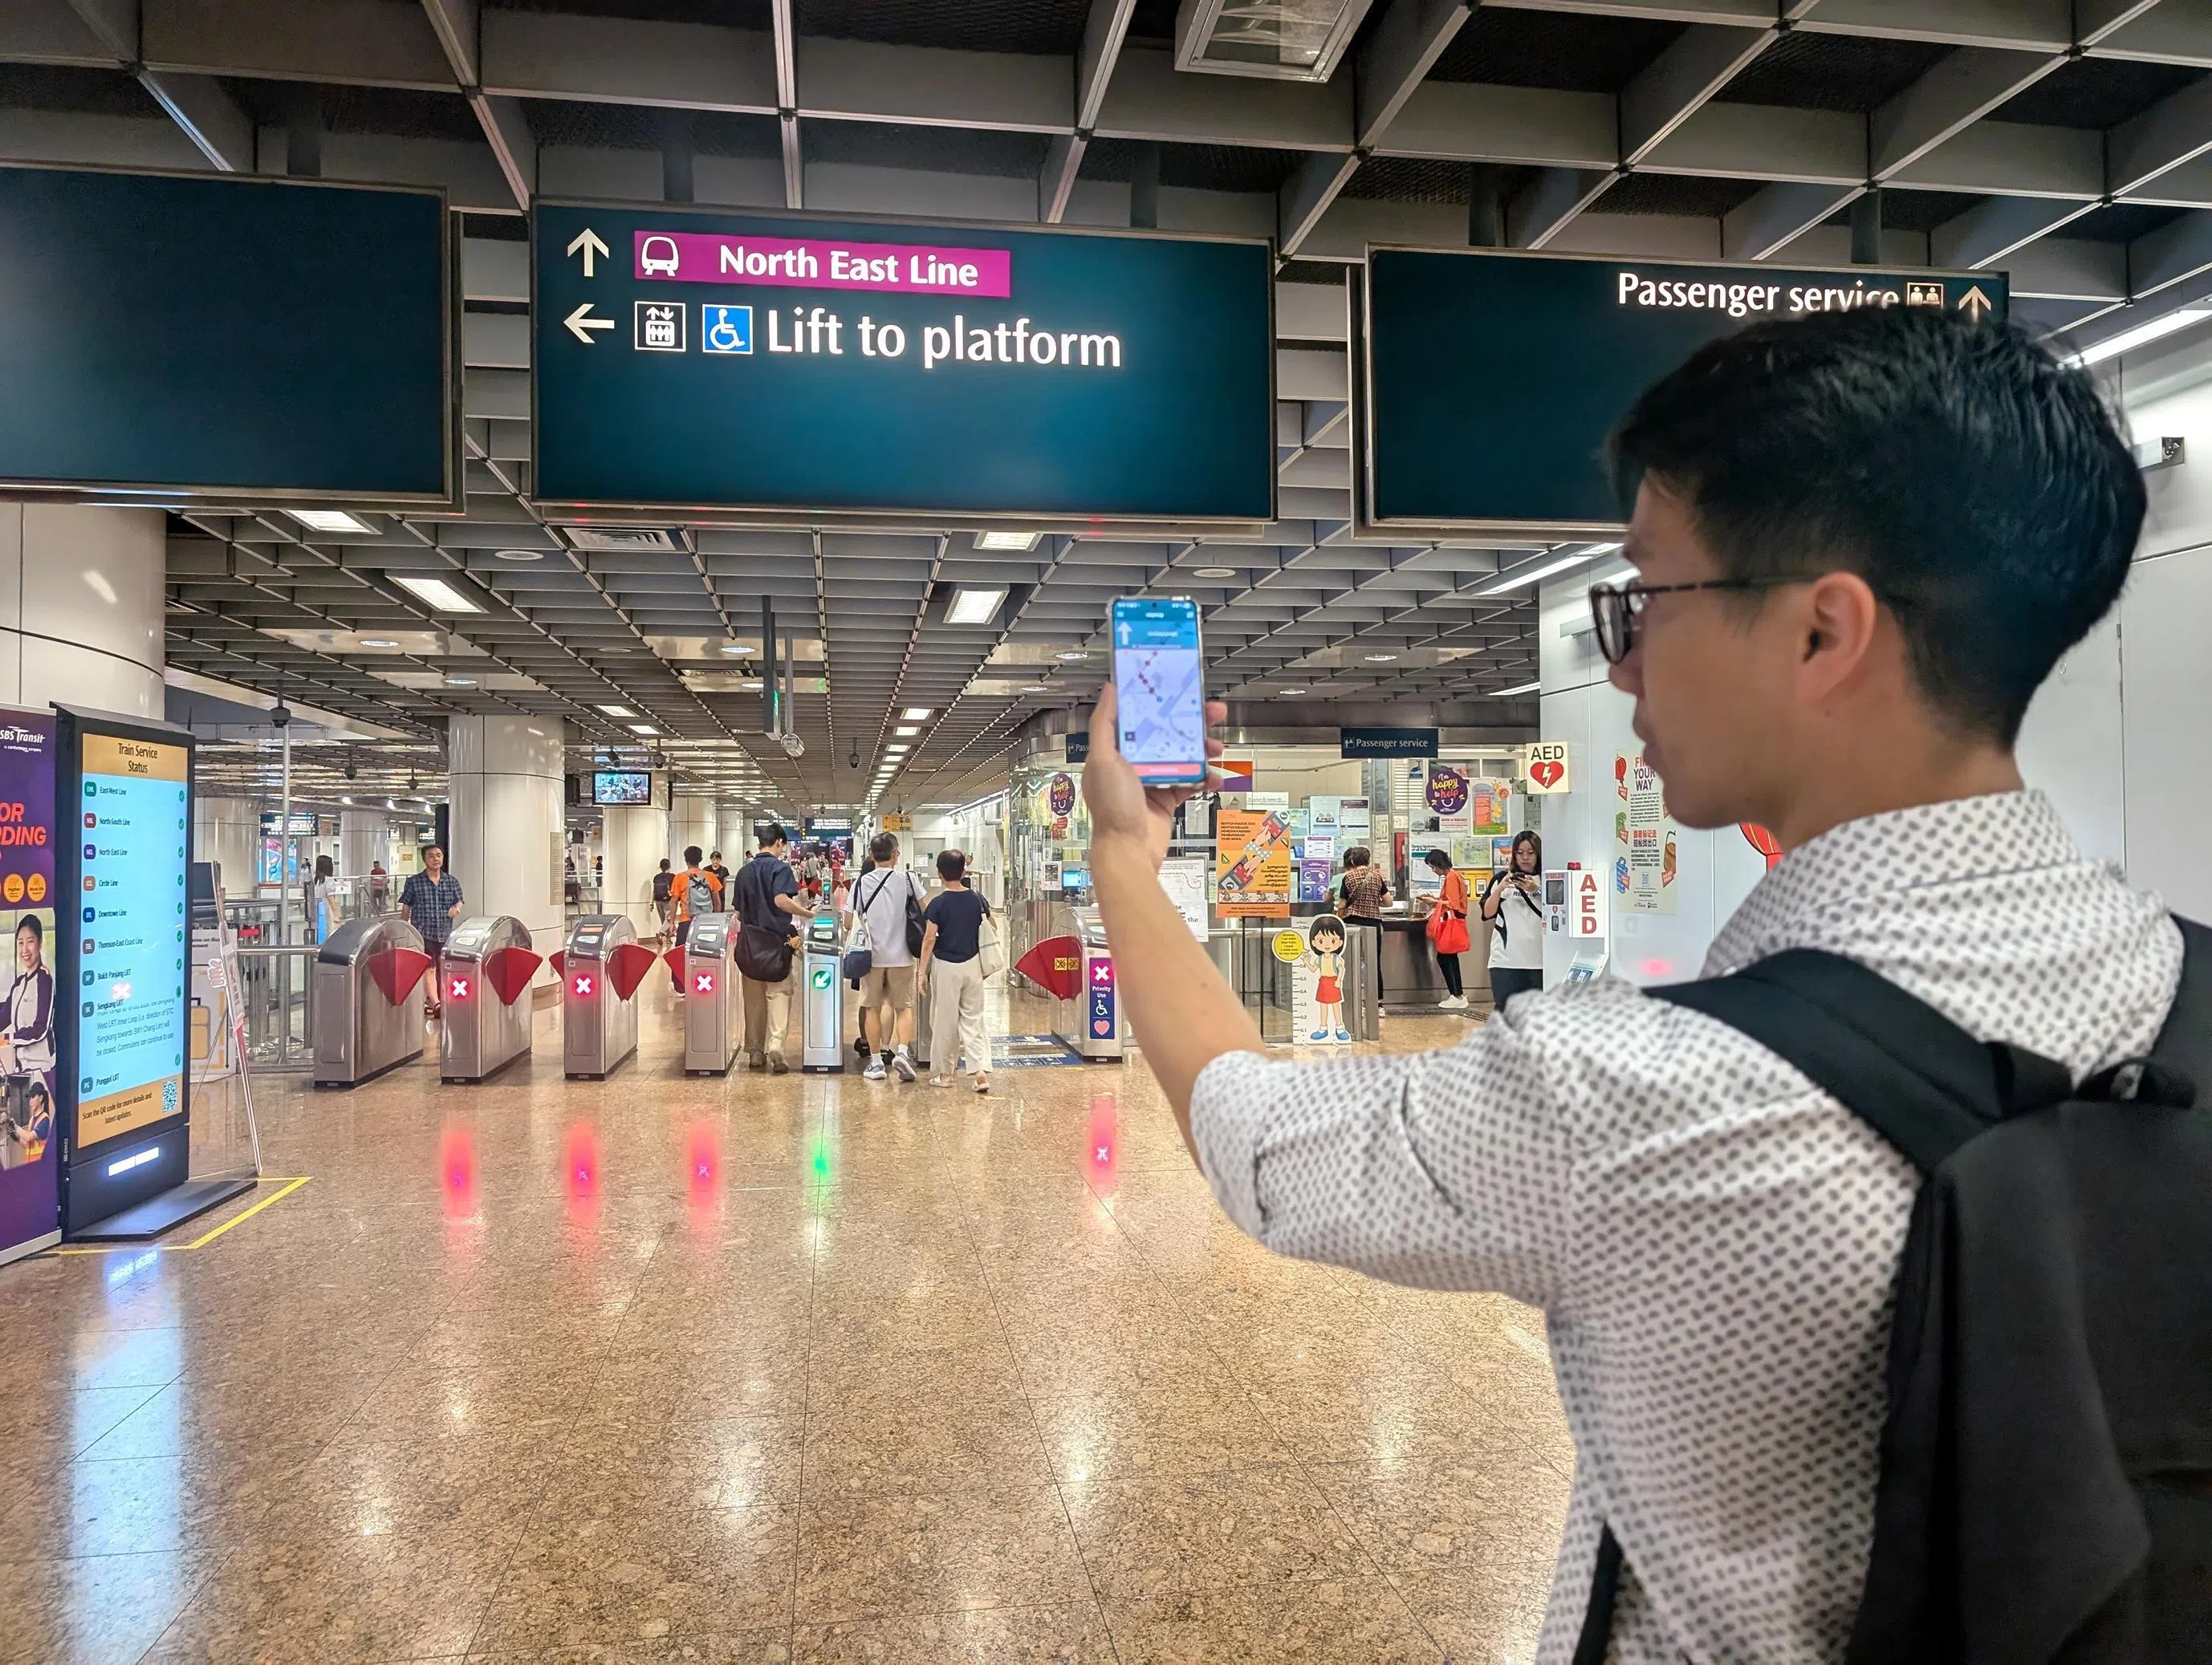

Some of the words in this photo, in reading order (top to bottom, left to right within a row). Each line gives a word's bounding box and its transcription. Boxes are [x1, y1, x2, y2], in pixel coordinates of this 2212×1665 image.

[720, 245, 817, 278] North
[830, 250, 899, 282] East
[910, 254, 978, 287] Line
[1618, 272, 1780, 318] Passenger
[1789, 279, 1899, 312] service
[768, 307, 844, 355] Lift
[857, 315, 905, 357] to
[923, 315, 1121, 369] platform
[0, 729, 14, 741] SBS
[12, 728, 46, 743] Transit
[1076, 743, 1089, 752] Pass
[1356, 738, 1397, 749] Passenger
[1399, 738, 1429, 747] service
[118, 742, 134, 755] Train
[136, 745, 158, 759] Service
[1531, 745, 1564, 761] AED
[128, 760, 148, 774] Status
[1633, 768, 1656, 779] YOUR
[1053, 780, 1070, 793] happy
[1432, 778, 1459, 790] happy
[1636, 779, 1653, 791] WAY
[100, 786, 118, 794] East-West
[1441, 789, 1458, 798] help
[0, 802, 24, 822] OR
[100, 818, 122, 826] North-South
[0, 826, 47, 846] DING
[112, 848, 120, 856] East
[99, 879, 110, 887] Circle
[1580, 874, 1598, 935] AED
[99, 910, 119, 918] Downtown
[119, 908, 127, 916] Line
[98, 940, 124, 949] Thomson-East
[124, 938, 135, 946] Coast
[98, 972, 108, 980] Bukit
[108, 971, 124, 979] Panjang
[97, 1001, 116, 1010] Sengkang
[96, 1034, 117, 1043] Sengkang
[118, 1041, 140, 1051] Commuters
[148, 1035, 163, 1044] continue
[96, 1077, 112, 1086] Punggol
[83, 1112, 92, 1120] Scan
[100, 1107, 106, 1115] QR
[107, 1105, 116, 1113] code
[133, 1094, 144, 1104] details
[105, 1115, 116, 1124] latest
